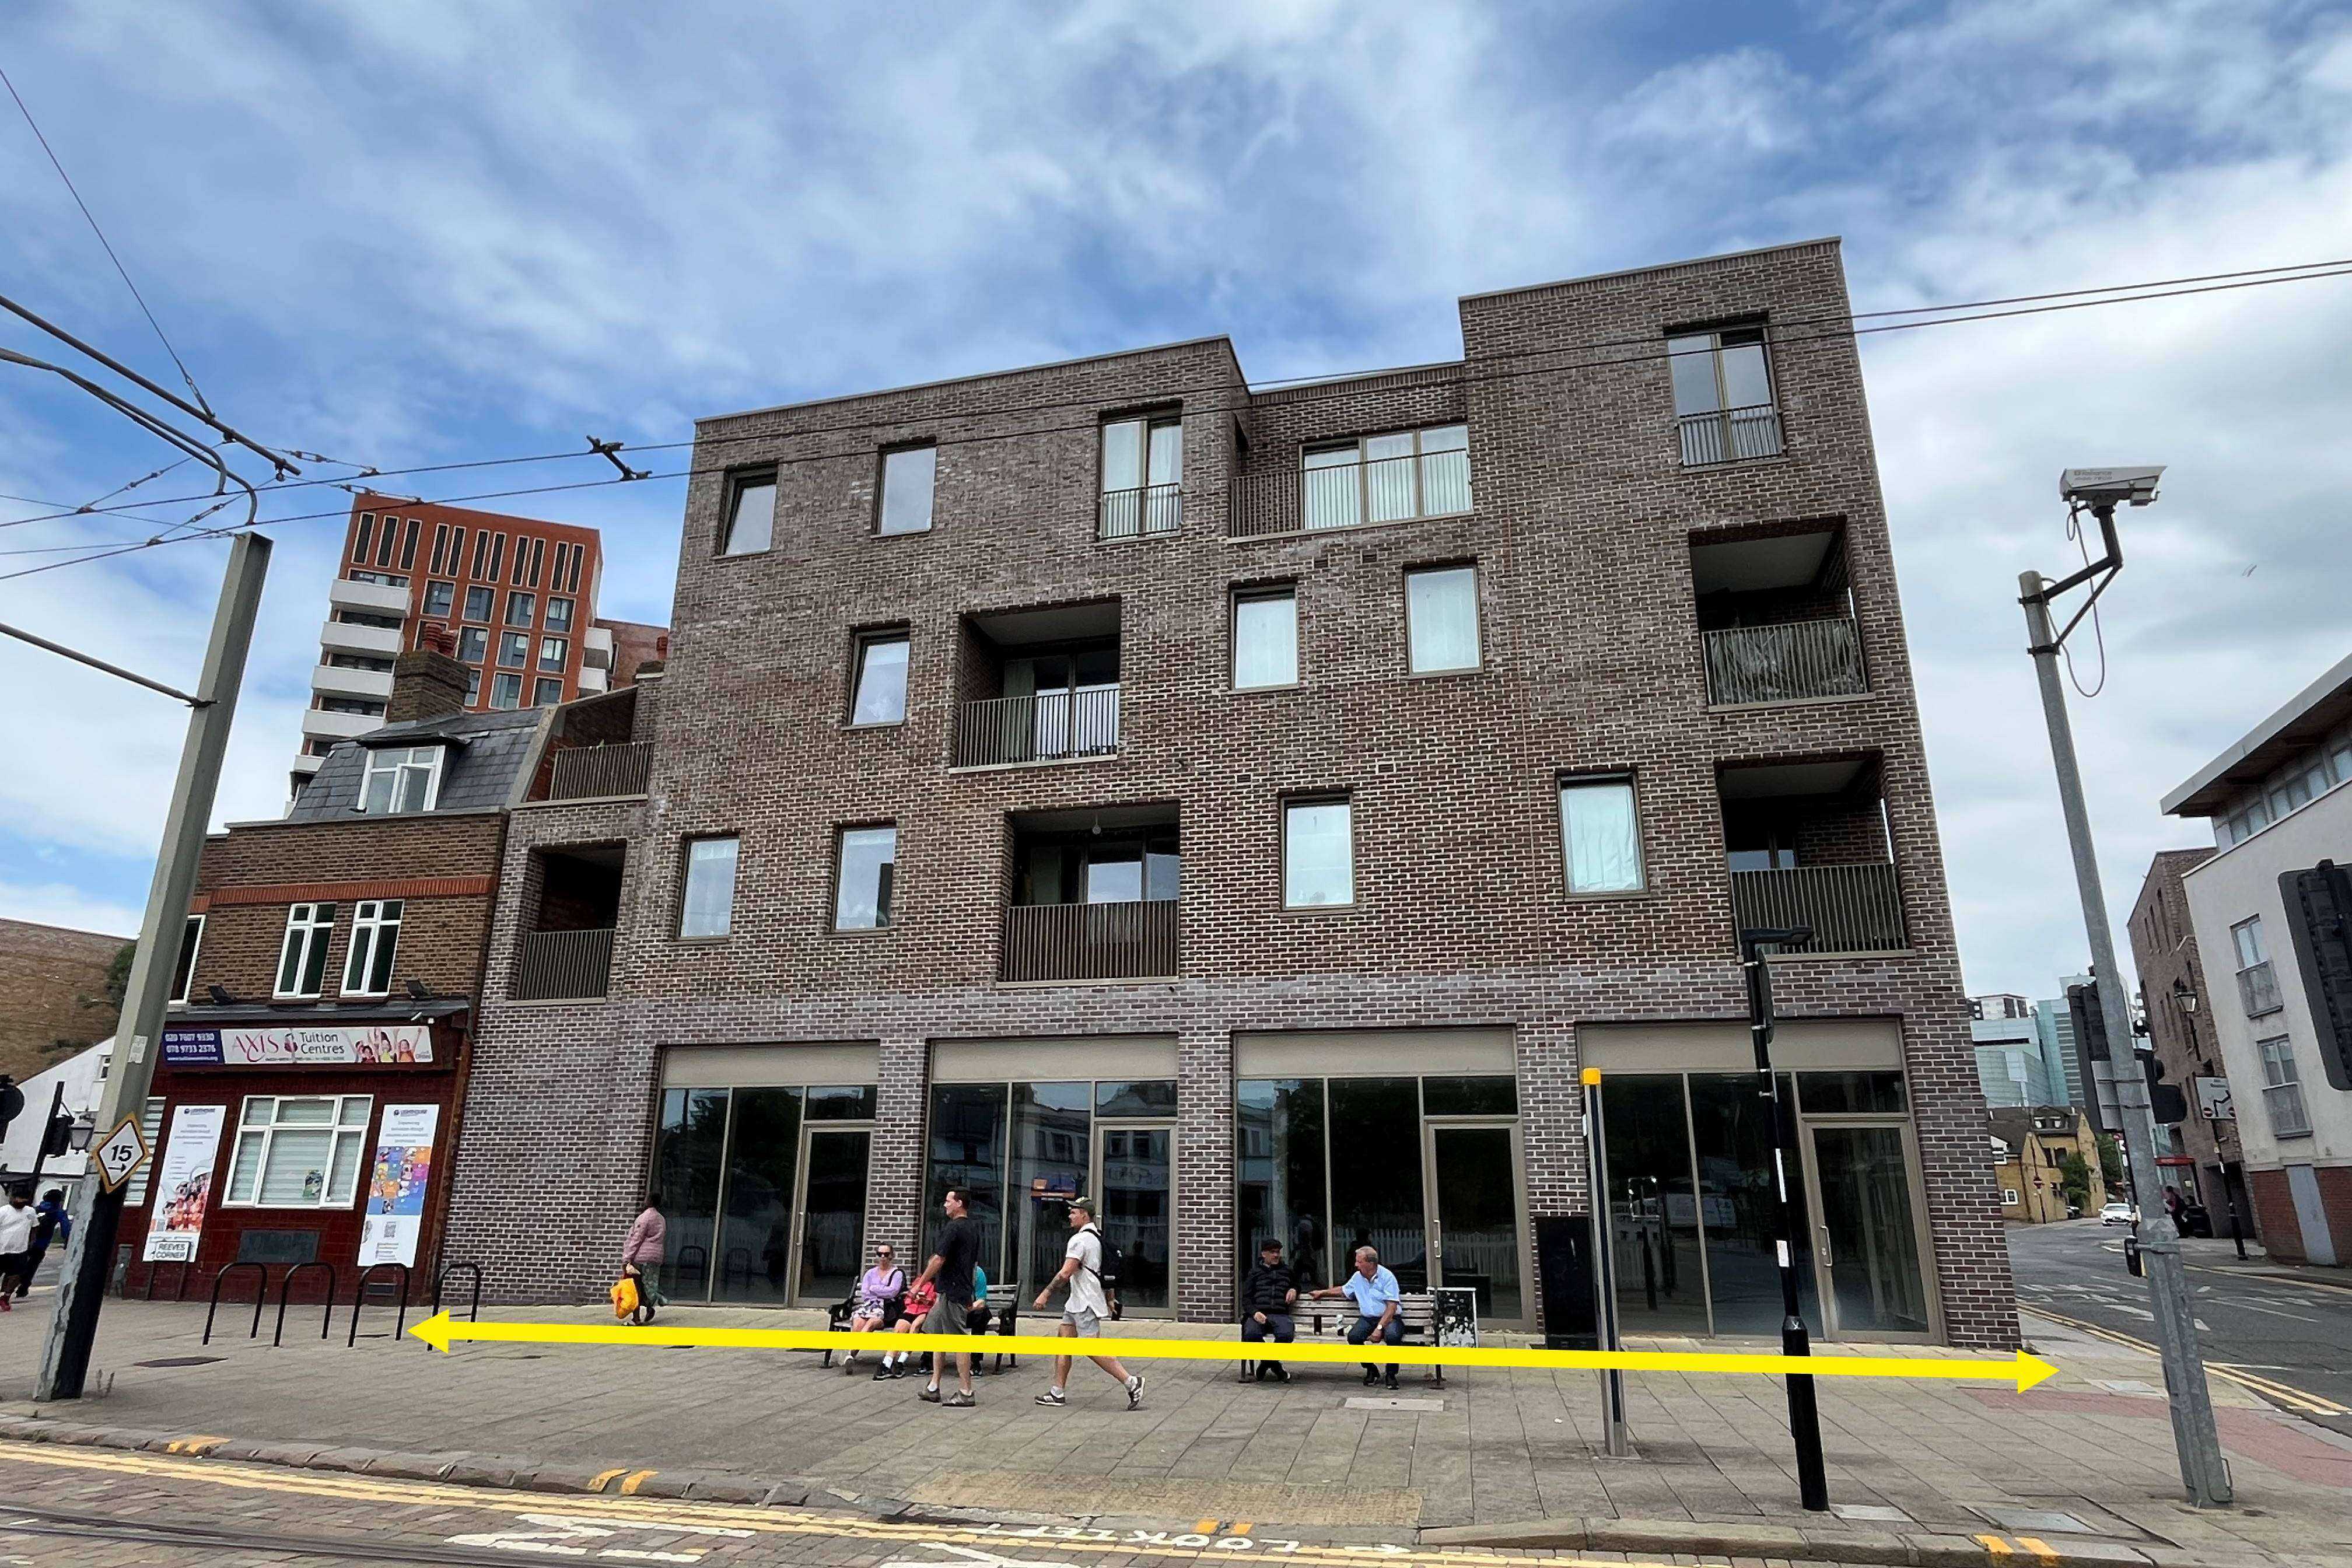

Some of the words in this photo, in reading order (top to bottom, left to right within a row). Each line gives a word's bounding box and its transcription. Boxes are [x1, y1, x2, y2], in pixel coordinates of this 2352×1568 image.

[300, 1031, 338, 1043] Tuition
[233, 1031, 279, 1062] AXIS
[300, 1044, 344, 1054] Centres
[111, 1144, 134, 1162] 15
[957, 1522, 1119, 1541] LEFT
[1121, 1530, 1300, 1553] LOOK
